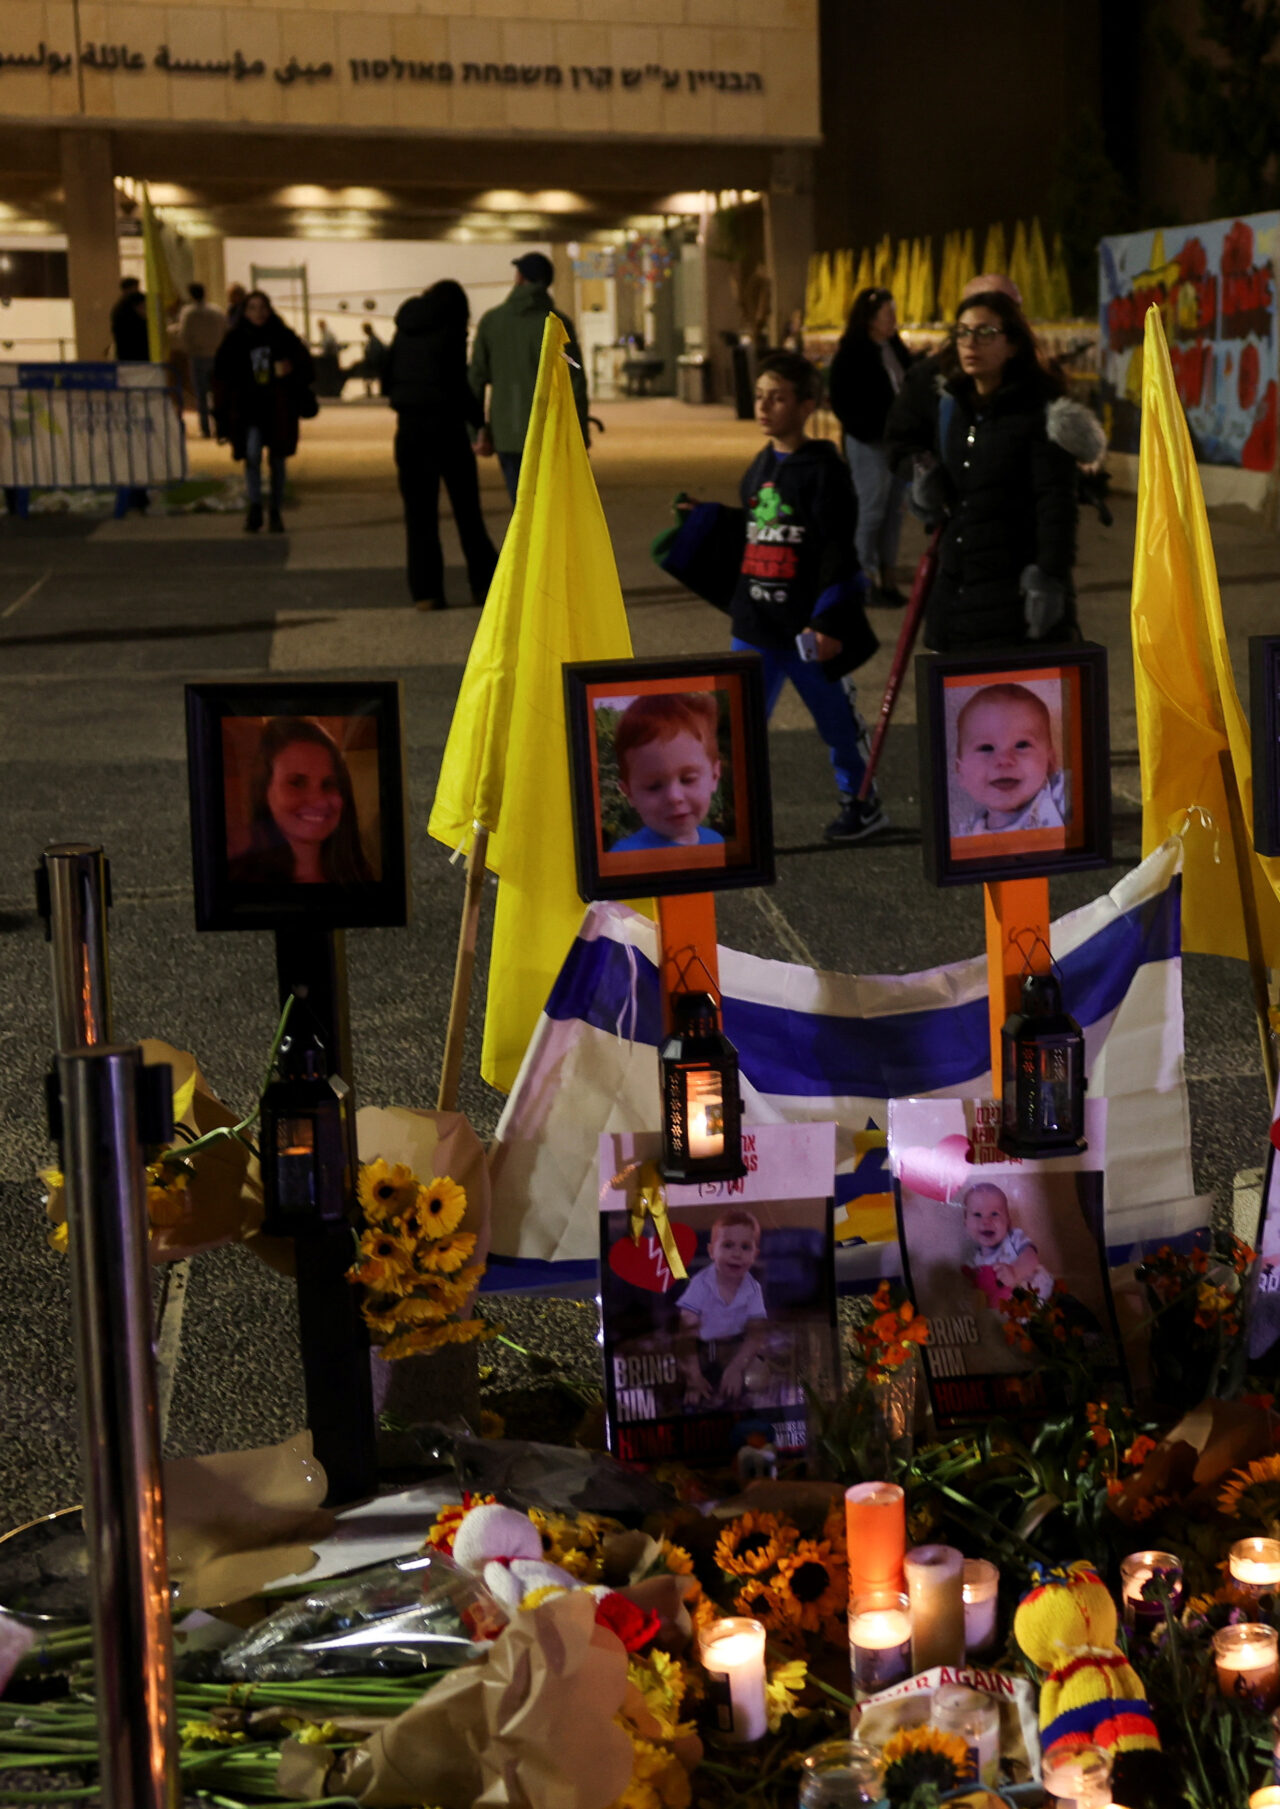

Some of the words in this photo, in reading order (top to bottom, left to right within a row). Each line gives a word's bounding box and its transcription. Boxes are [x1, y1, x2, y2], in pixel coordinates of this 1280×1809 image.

[348, 55, 454, 83] פאולסון
[461, 61, 562, 87] משפחת
[570, 65, 614, 91] קרן
[687, 68, 764, 94] הבניין
[926, 1315, 979, 1346] BRING
[613, 1353, 677, 1390] BRING
[928, 1347, 967, 1378] HIM
[615, 1387, 657, 1423] HIM
[617, 1423, 676, 1461] HOME
[940, 1665, 1015, 1695] AGAIN
